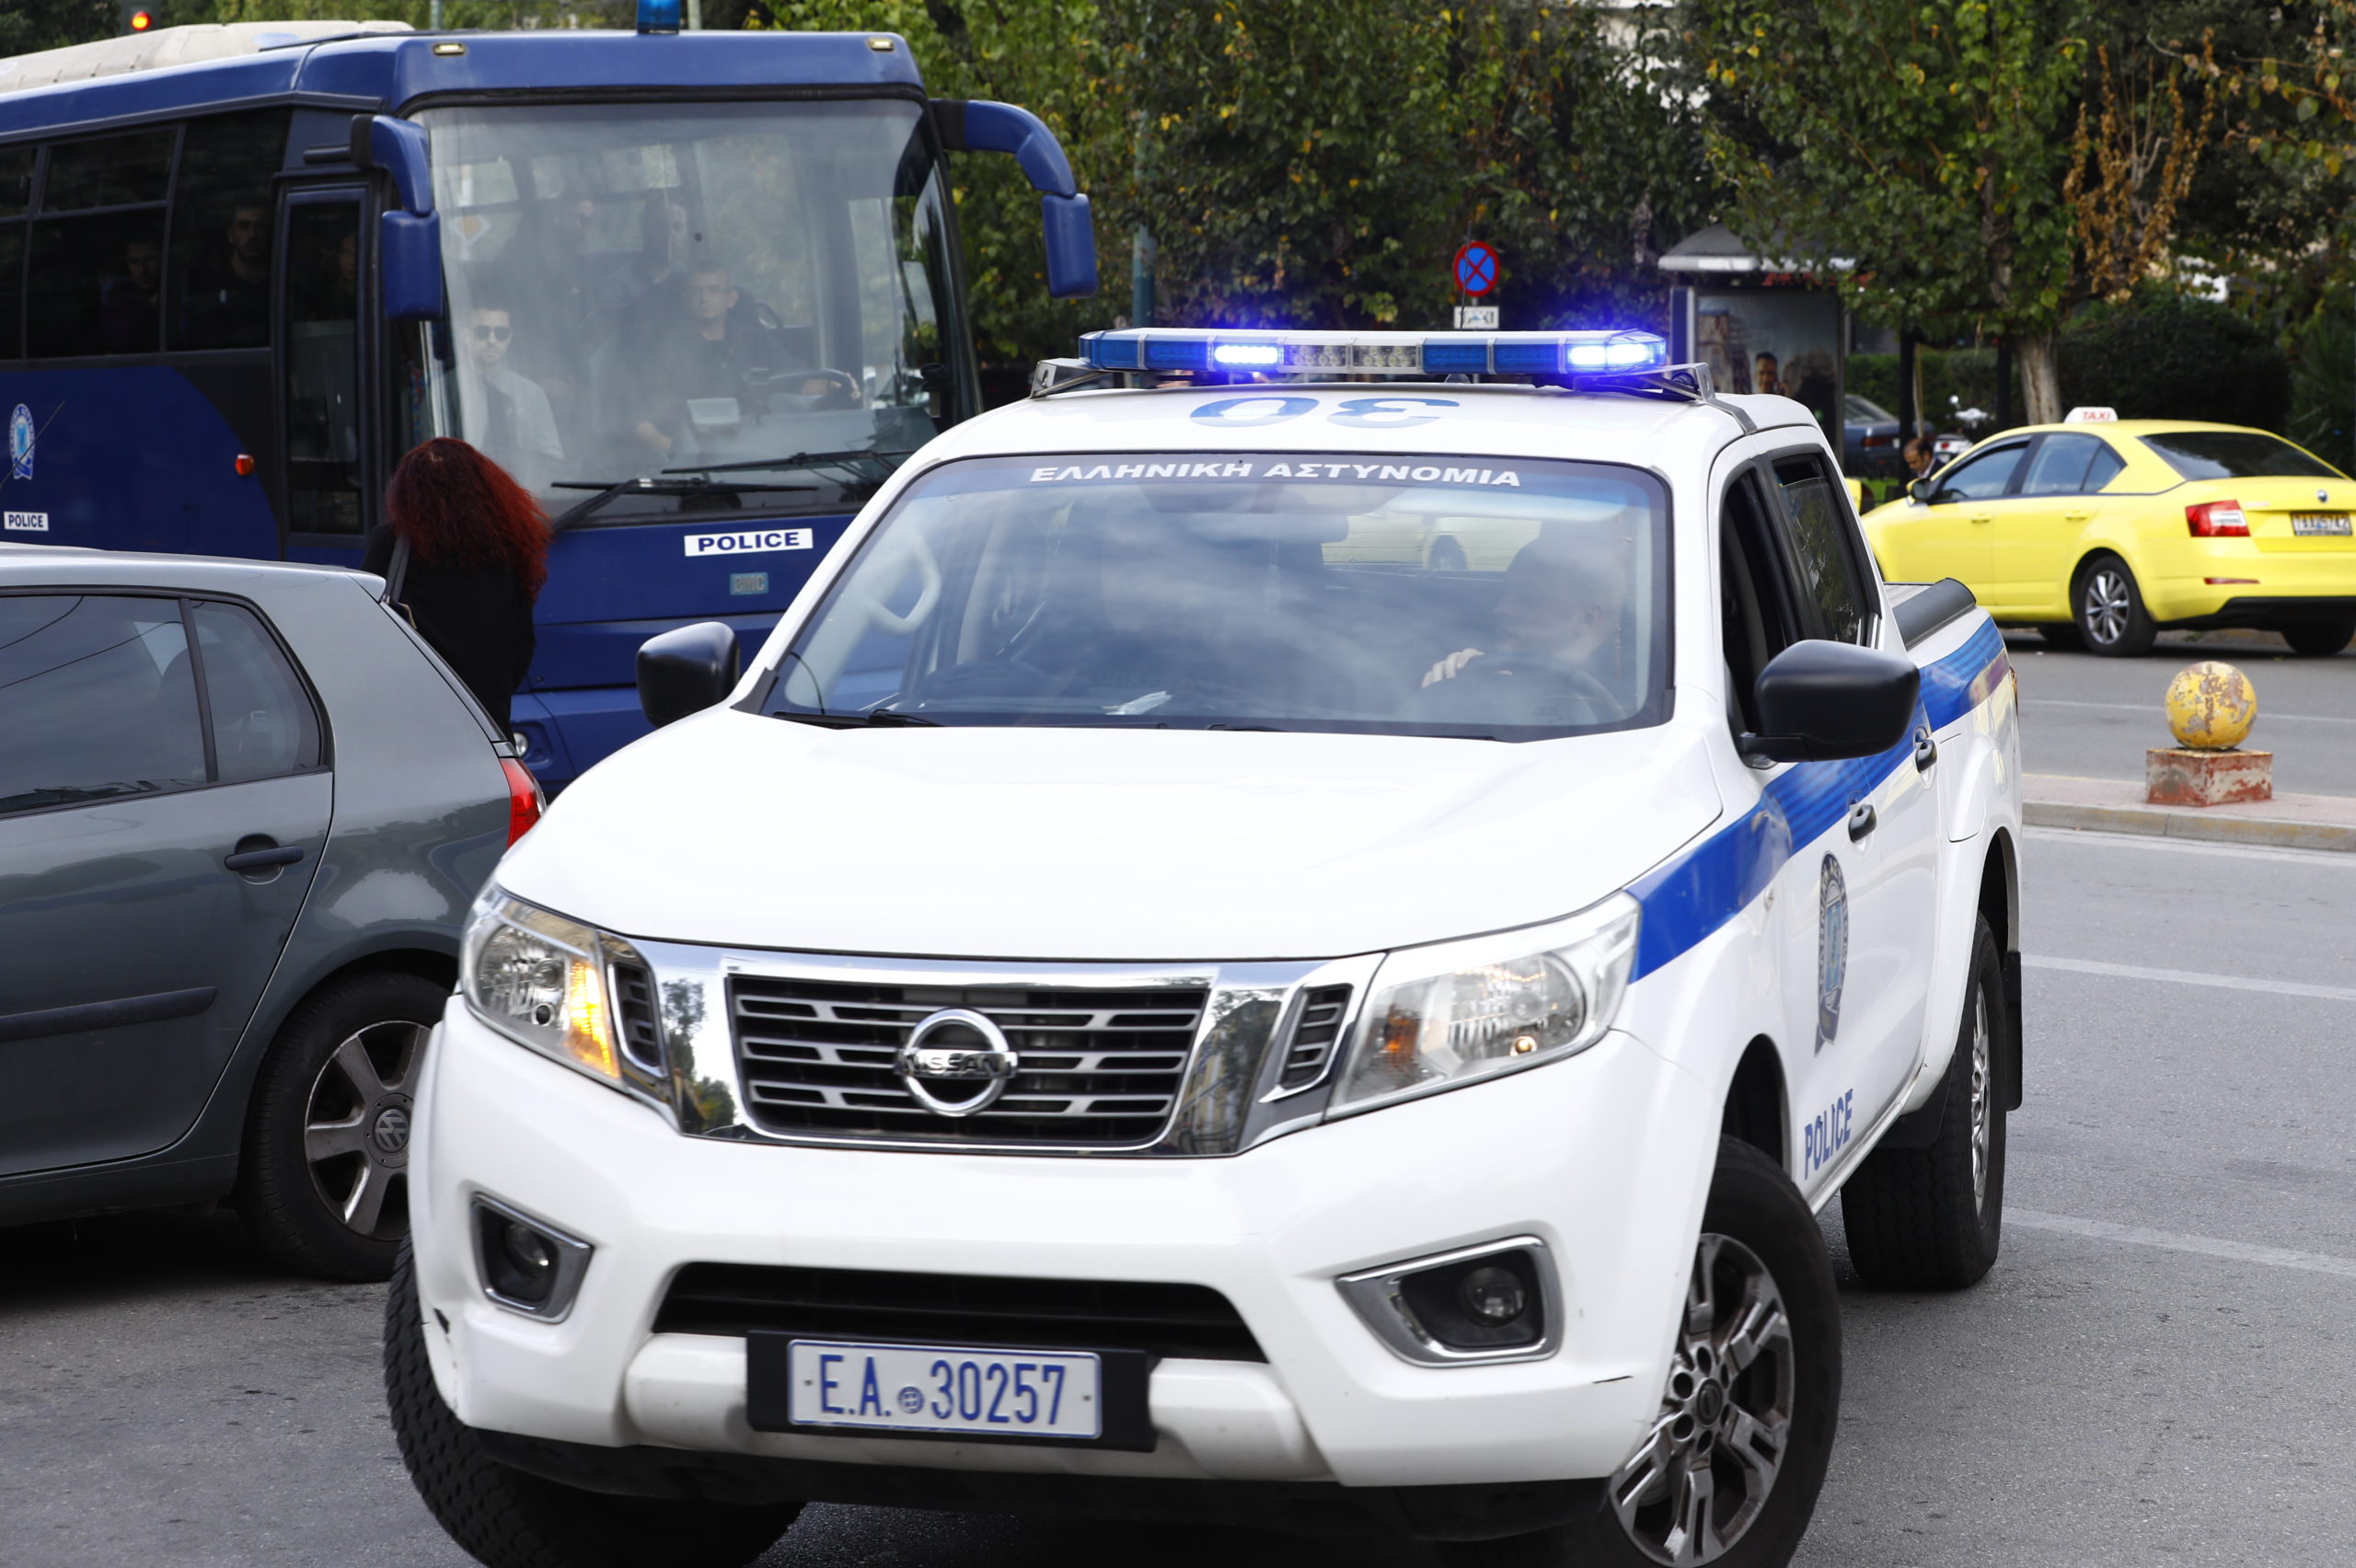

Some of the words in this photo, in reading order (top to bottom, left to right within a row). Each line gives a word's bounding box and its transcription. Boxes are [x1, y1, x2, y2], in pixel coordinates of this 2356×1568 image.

[2083, 411, 2111, 421] TAXI
[1030, 463, 1252, 482] ΕΛΛΗΝΙΚΗ
[1263, 463, 1520, 486] ΑΣΤΥΝΟΜΙΑ
[8, 513, 43, 527] POLICE
[699, 532, 800, 552] POLICE
[734, 574, 766, 593] BMC
[906, 1053, 1009, 1075] NISSAN
[1804, 1089, 1854, 1180] POLICE
[930, 1358, 1066, 1425] 30257
